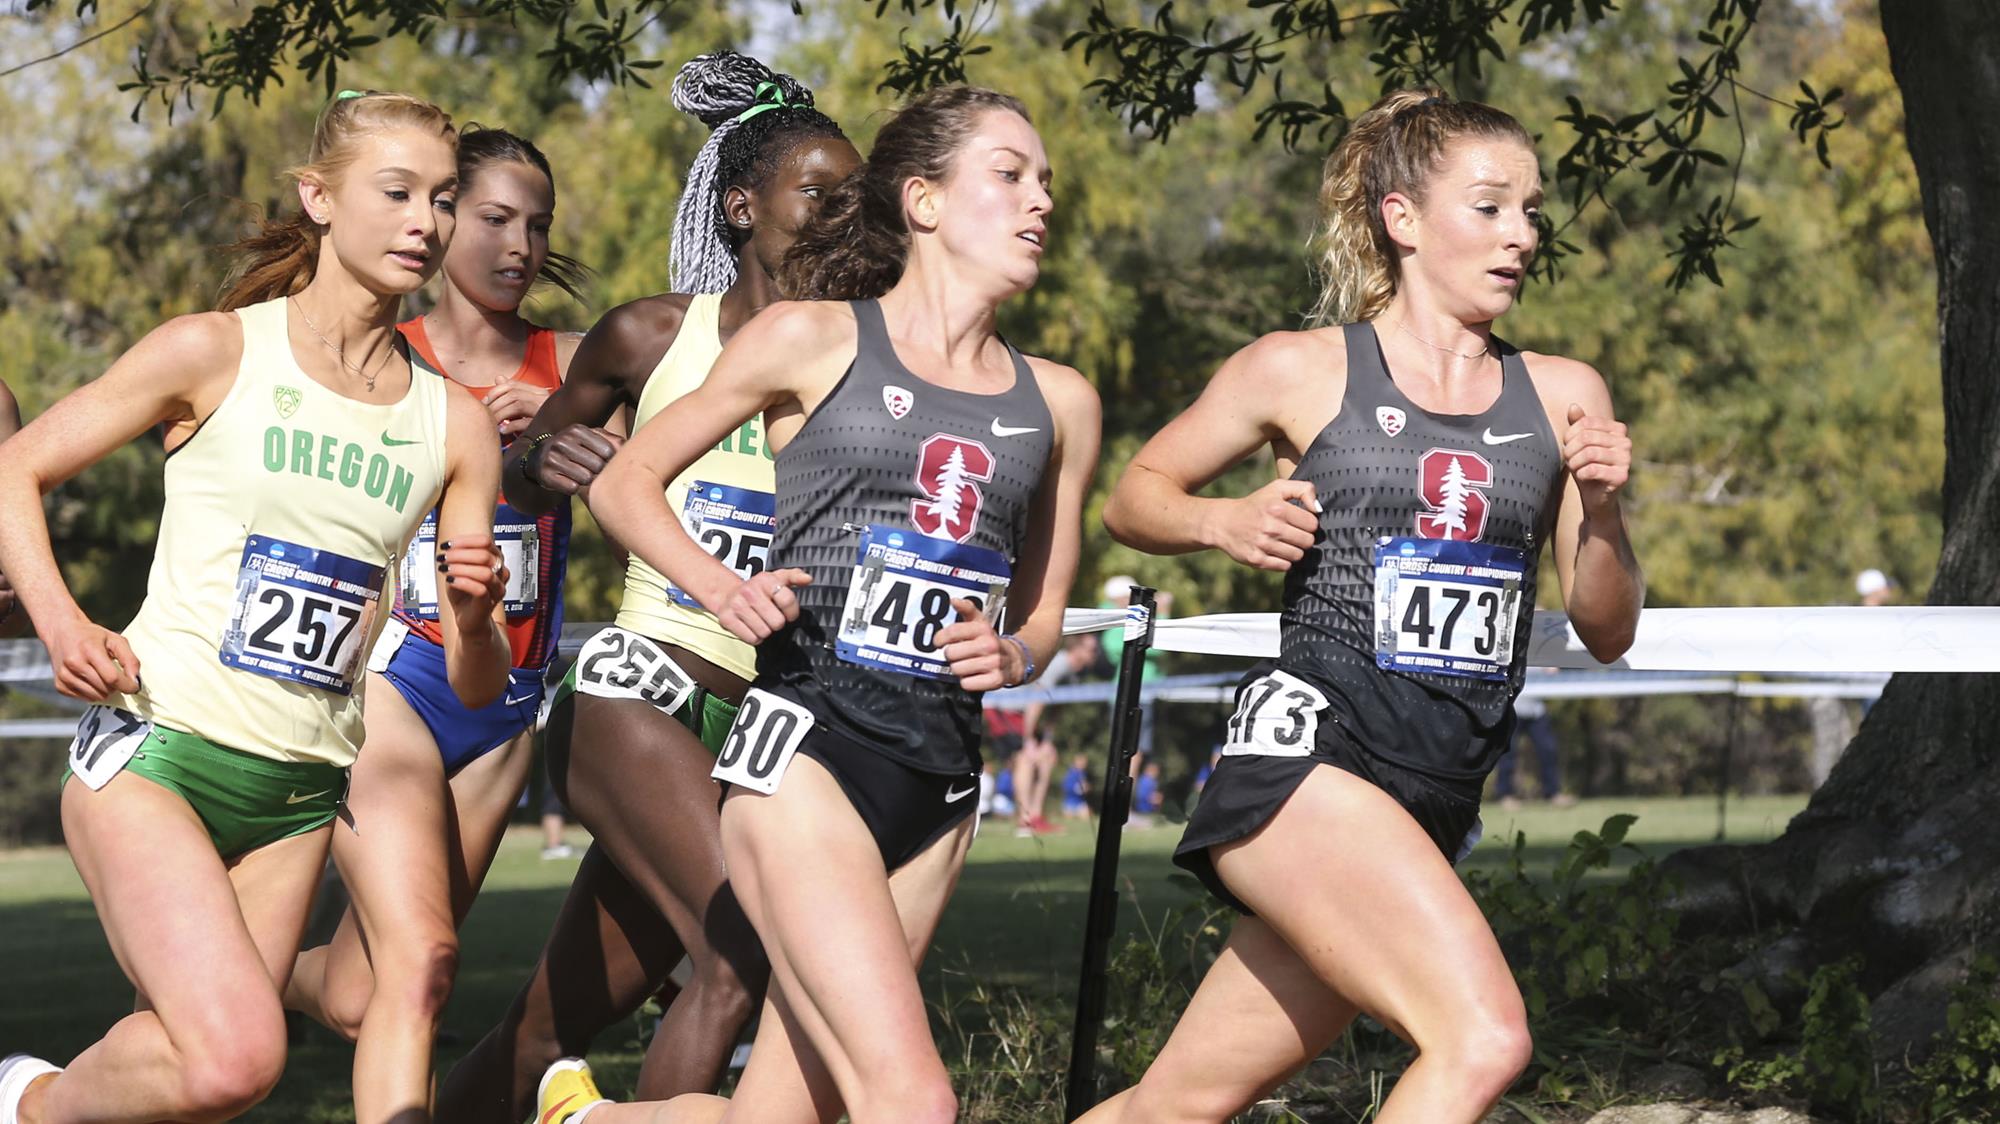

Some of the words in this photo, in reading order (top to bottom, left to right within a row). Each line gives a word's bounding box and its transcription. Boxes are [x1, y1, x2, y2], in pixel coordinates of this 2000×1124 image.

[263, 426, 415, 515] OREGON
[493, 524, 537, 533] MPIONSHIPS
[731, 510, 769, 525] COUNTRY
[263, 562, 296, 579] CROSS
[294, 569, 334, 588] COUNTRY
[701, 528, 770, 580] 25
[1399, 560, 1428, 573] CROSS
[1428, 563, 1466, 576] COUNTRY
[1465, 566, 1523, 581] CHAMPIONSHIPS
[248, 588, 361, 667] 257
[1401, 586, 1499, 656] 473
[581, 632, 689, 707] 255
